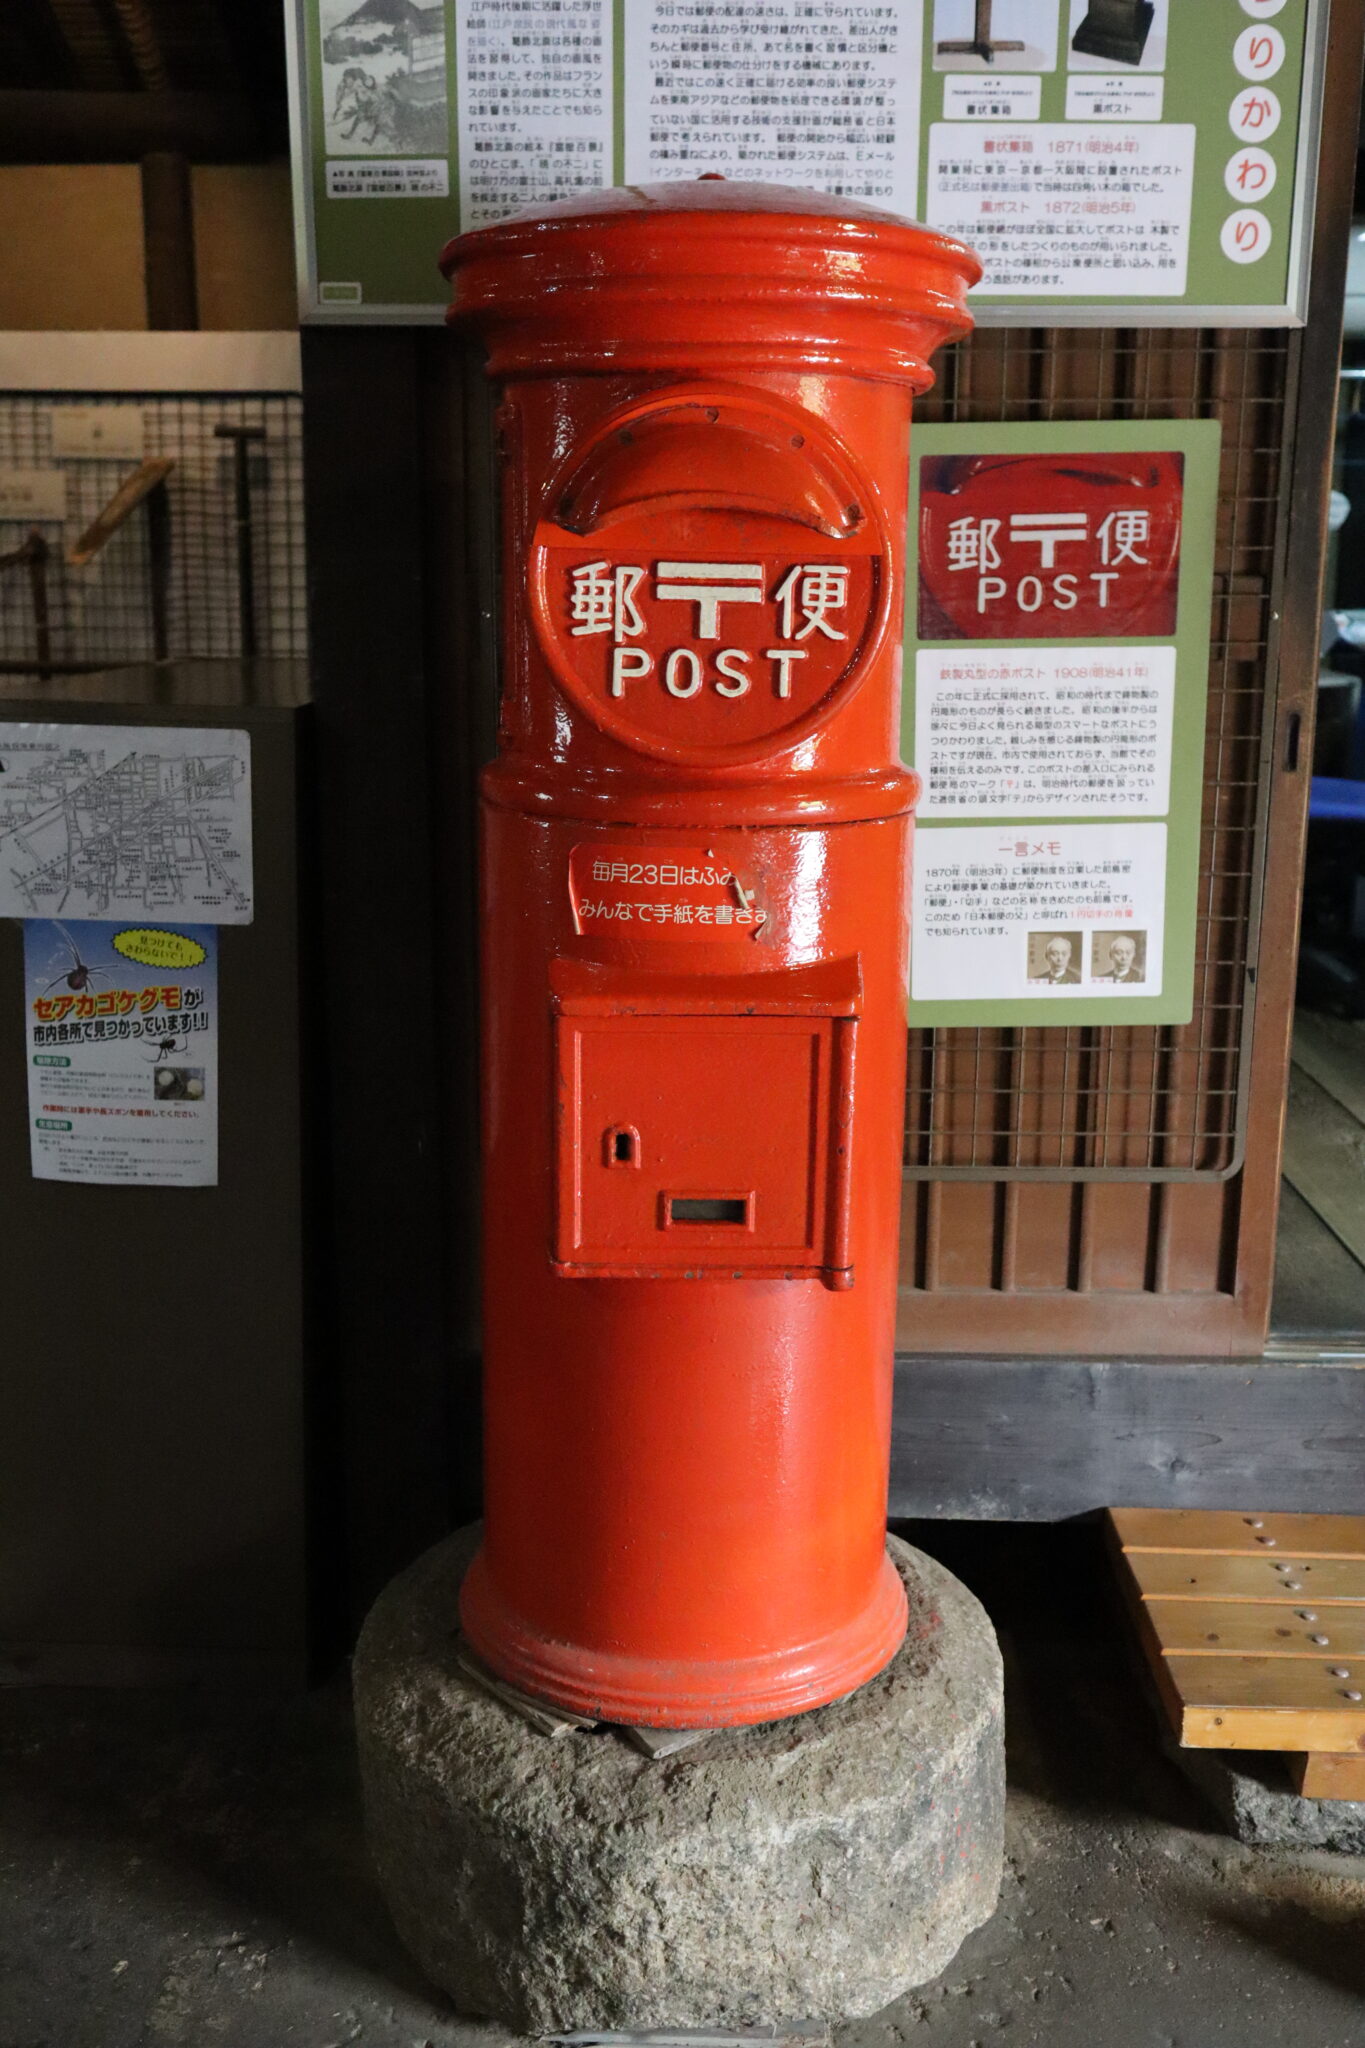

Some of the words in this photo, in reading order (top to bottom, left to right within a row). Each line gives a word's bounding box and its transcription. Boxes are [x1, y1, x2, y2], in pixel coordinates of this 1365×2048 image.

[469, 122, 522, 132] れています。
[977, 572, 1120, 614] POST
[611, 648, 807, 699] POST
[998, 841, 1062, 857] 一言メモ
[925, 926, 1009, 937] でも知られています。
[33, 985, 203, 1022] セアカゴケグモが
